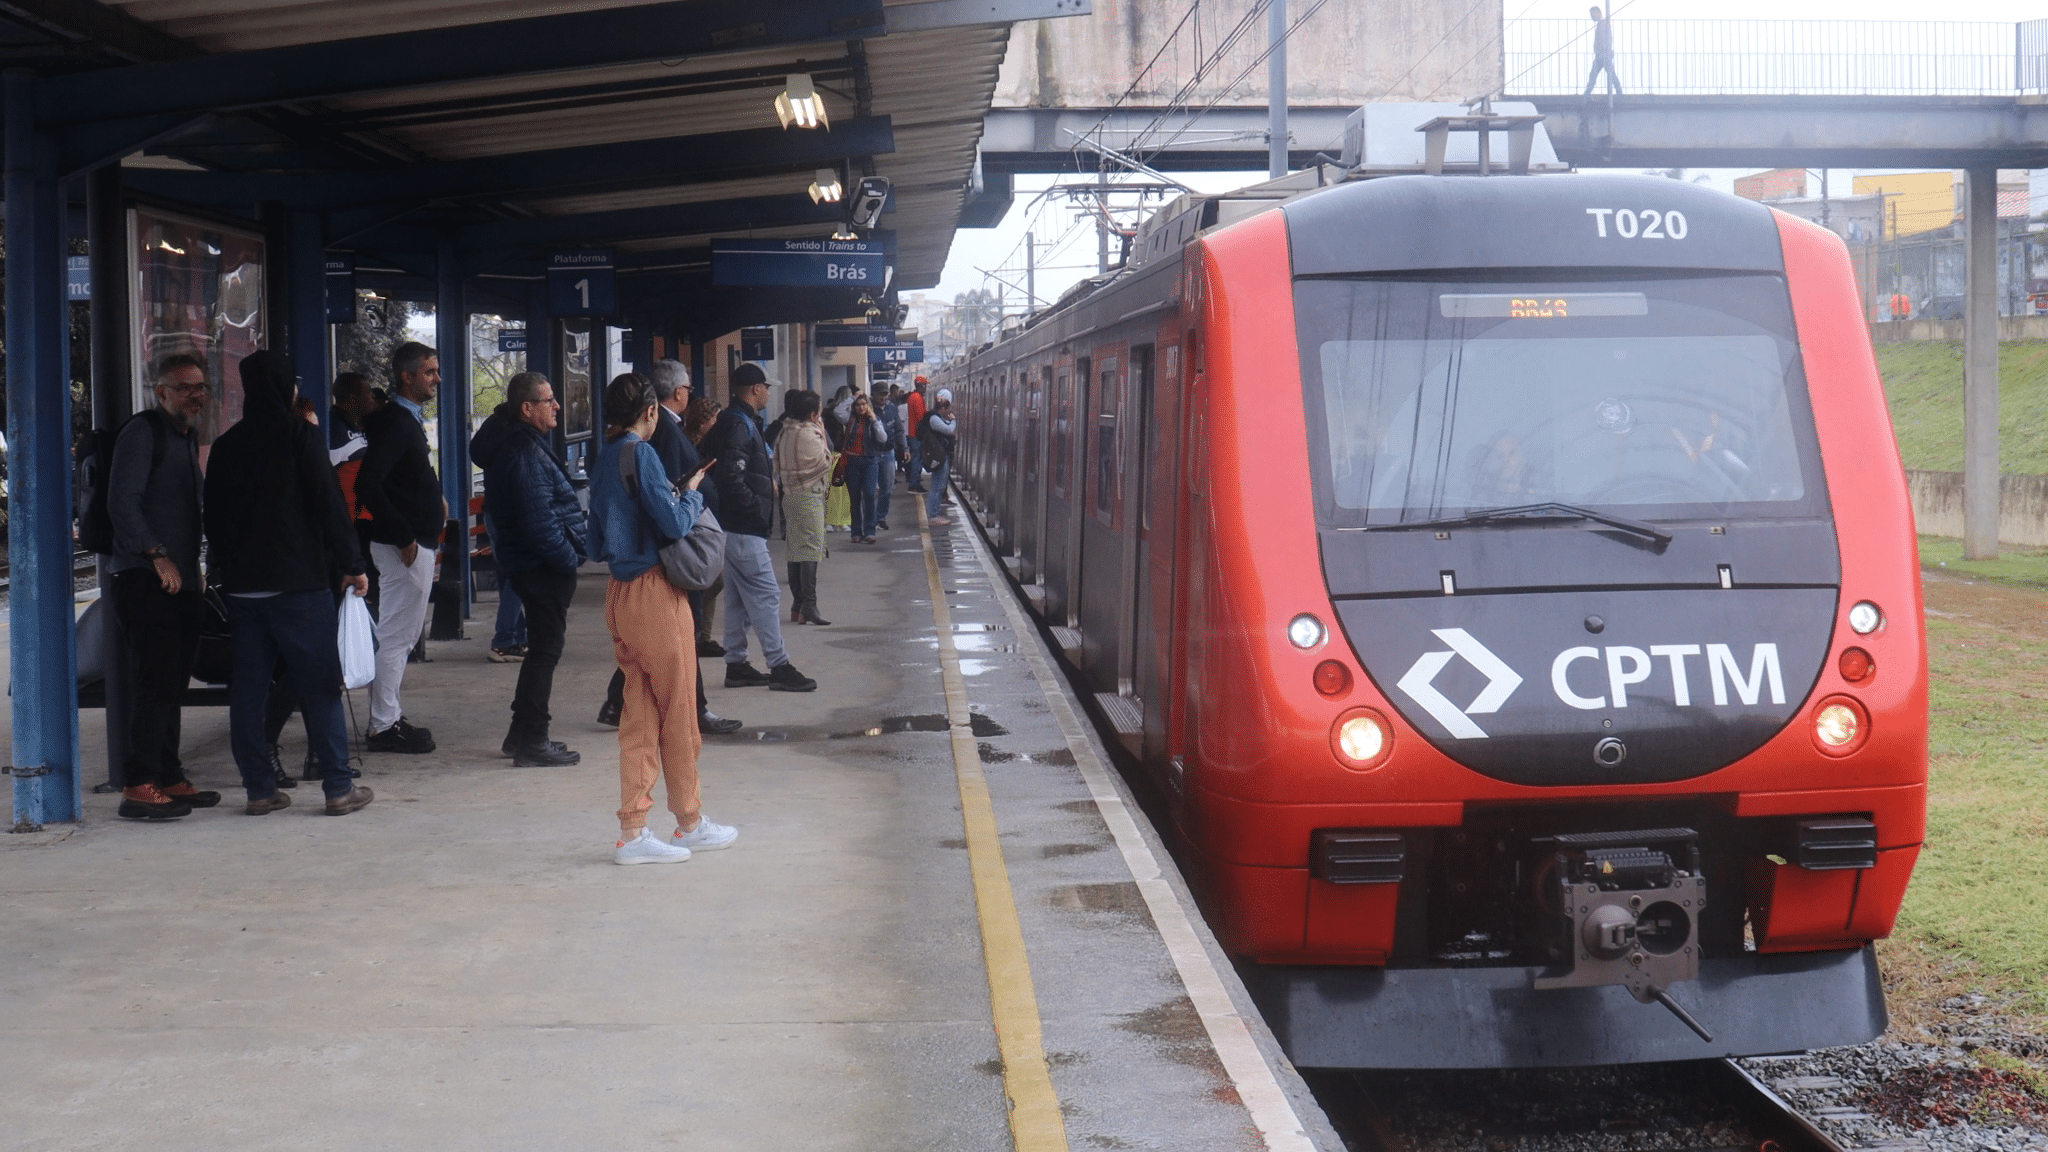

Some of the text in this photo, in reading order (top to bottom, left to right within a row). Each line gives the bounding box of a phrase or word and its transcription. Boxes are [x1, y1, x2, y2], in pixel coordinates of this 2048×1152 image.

[1585, 208, 1688, 240] T020
[785, 241, 867, 251] Sentido Trains to
[554, 254, 607, 263] Plataforma
[827, 263, 867, 280] Brás
[575, 279, 589, 308] 1
[868, 335, 888, 343] Brás
[754, 343, 761, 356] 1
[1551, 643, 1787, 710] CPTM
